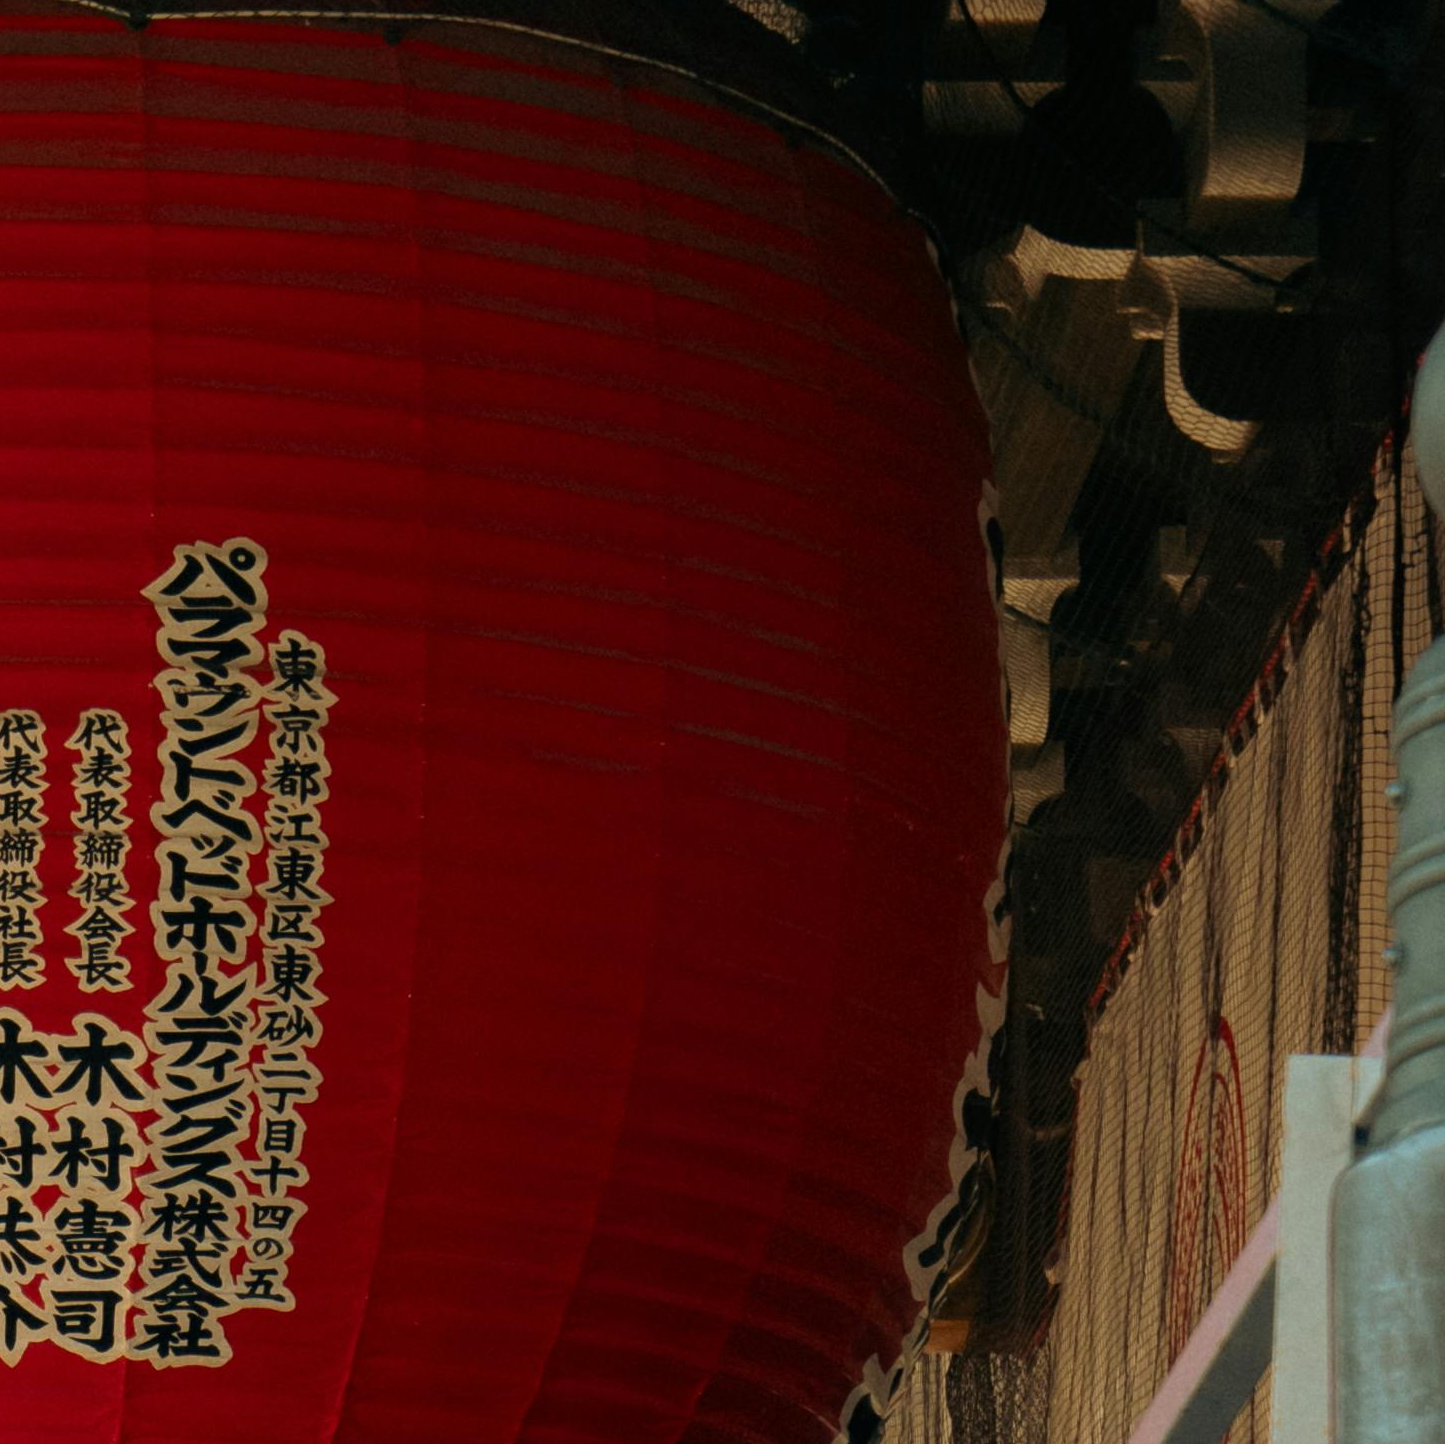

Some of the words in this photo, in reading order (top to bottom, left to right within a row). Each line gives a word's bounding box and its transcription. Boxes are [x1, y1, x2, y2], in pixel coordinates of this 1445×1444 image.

[235, 638, 322, 1304] 東京都江東区東砂二丁目十四の五
